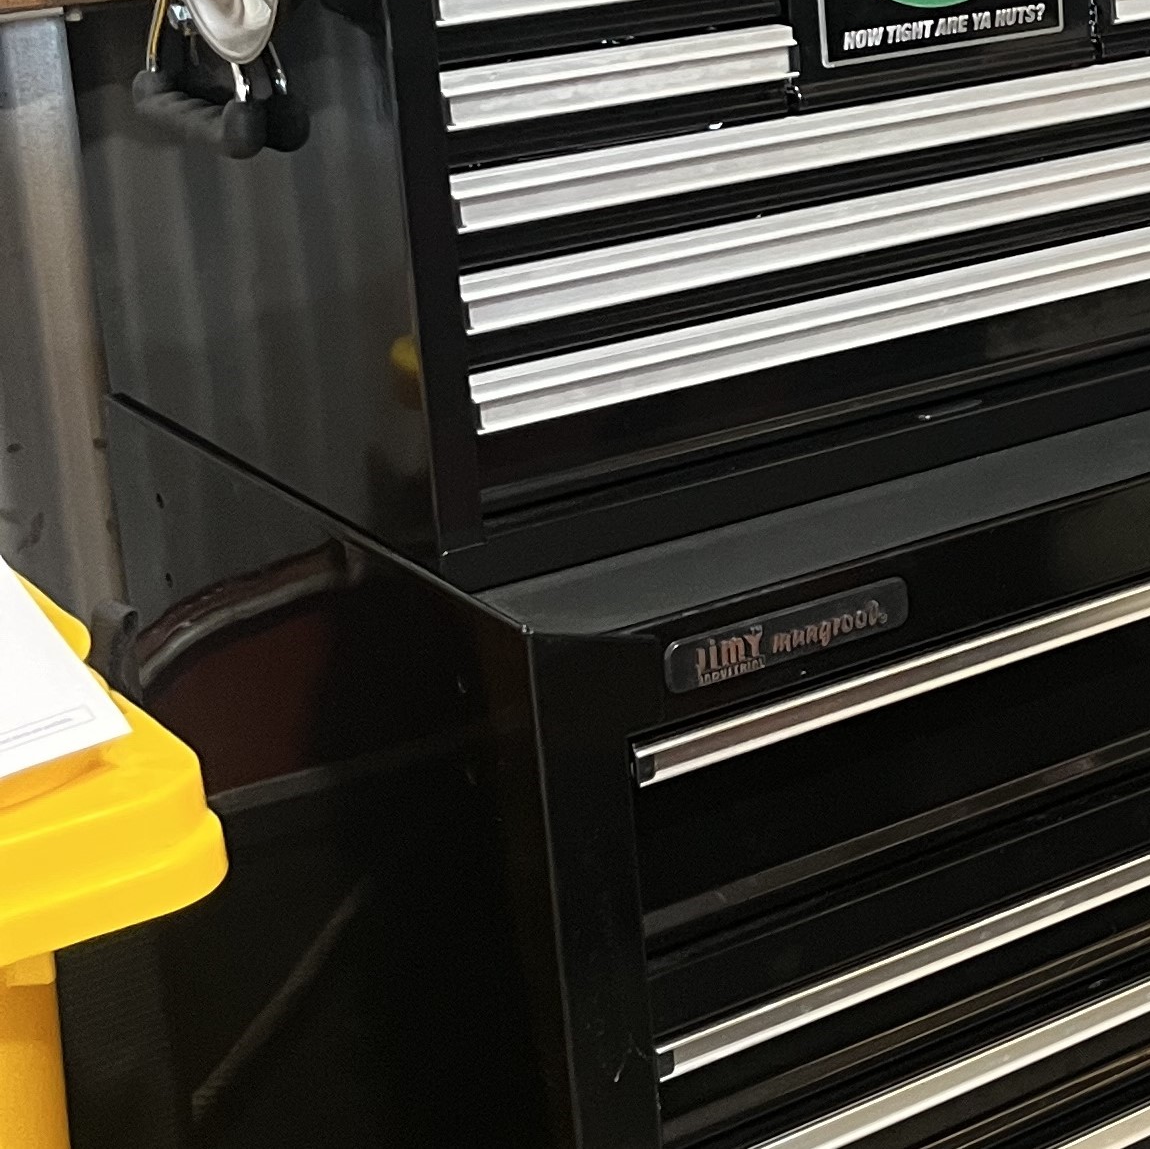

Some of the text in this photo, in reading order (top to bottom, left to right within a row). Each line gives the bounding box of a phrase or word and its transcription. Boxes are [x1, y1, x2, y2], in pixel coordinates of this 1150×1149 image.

[886, 19, 934, 44] TIGHT
[935, 14, 969, 37] ARE
[972, 11, 991, 31] YA
